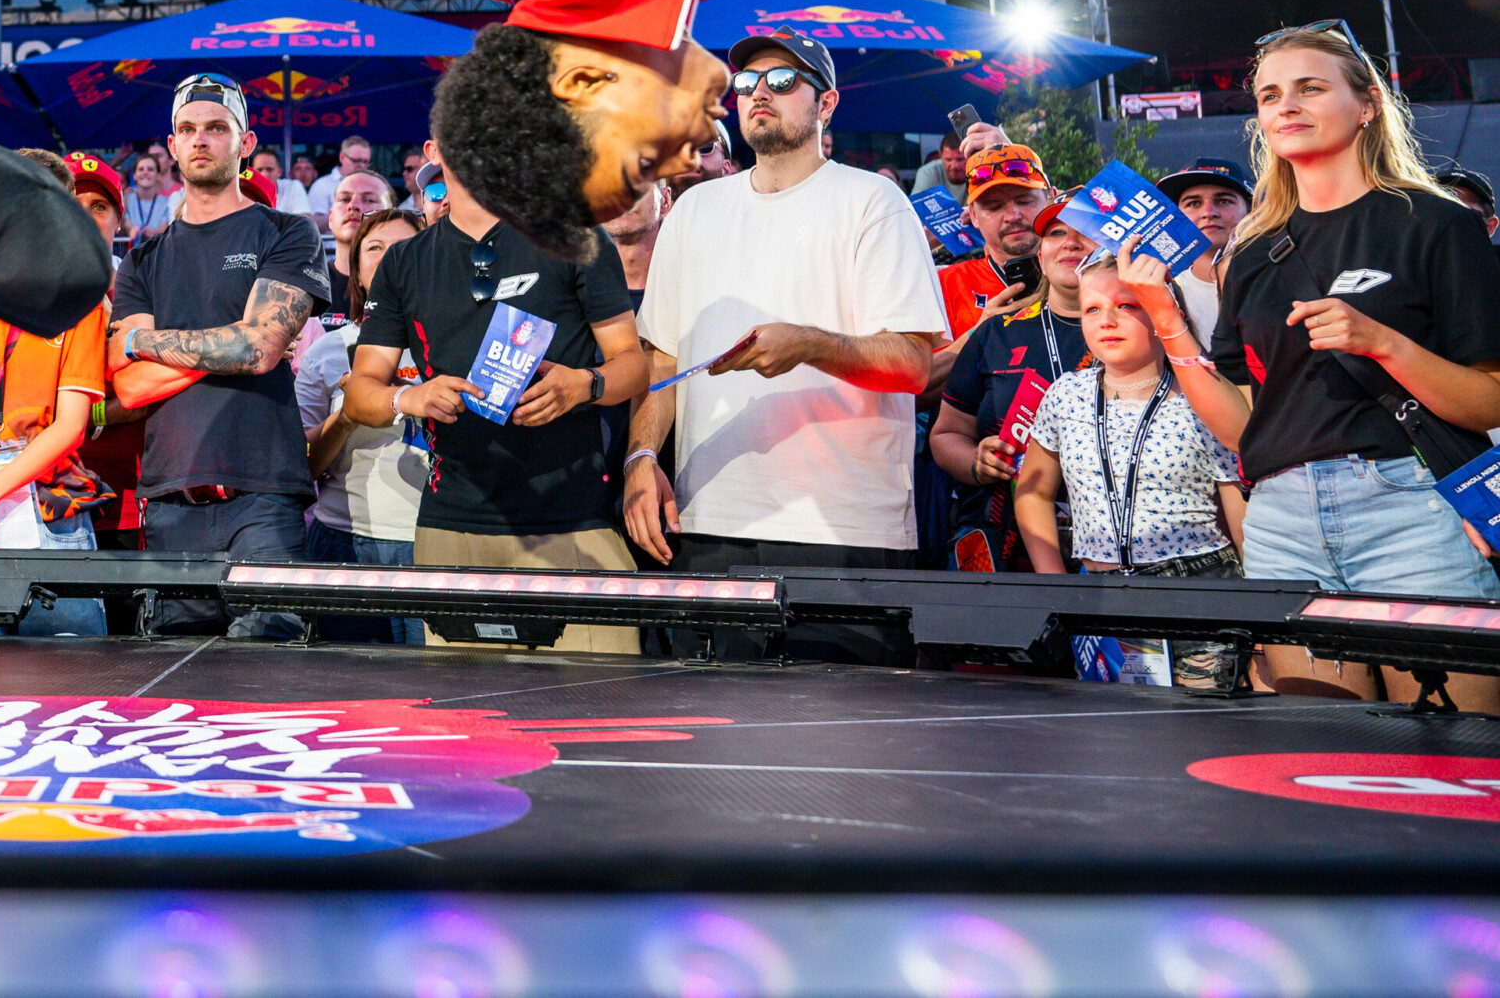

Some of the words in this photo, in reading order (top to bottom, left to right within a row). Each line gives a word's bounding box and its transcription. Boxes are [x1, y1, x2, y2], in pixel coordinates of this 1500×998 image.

[190, 34, 280, 50] Red
[288, 34, 376, 48] Bull
[745, 25, 844, 39] Rd
[847, 25, 946, 40] Bull
[1100, 189, 1159, 242] BLUE
[1139, 224, 1162, 245] AUGUST
[492, 272, 540, 301] 27
[1328, 268, 1393, 296] 27
[486, 340, 536, 374] BLUE
[1008, 346, 1028, 366] 1
[1454, 474, 1482, 493] TICKET!
[50, 777, 413, 809] Red
